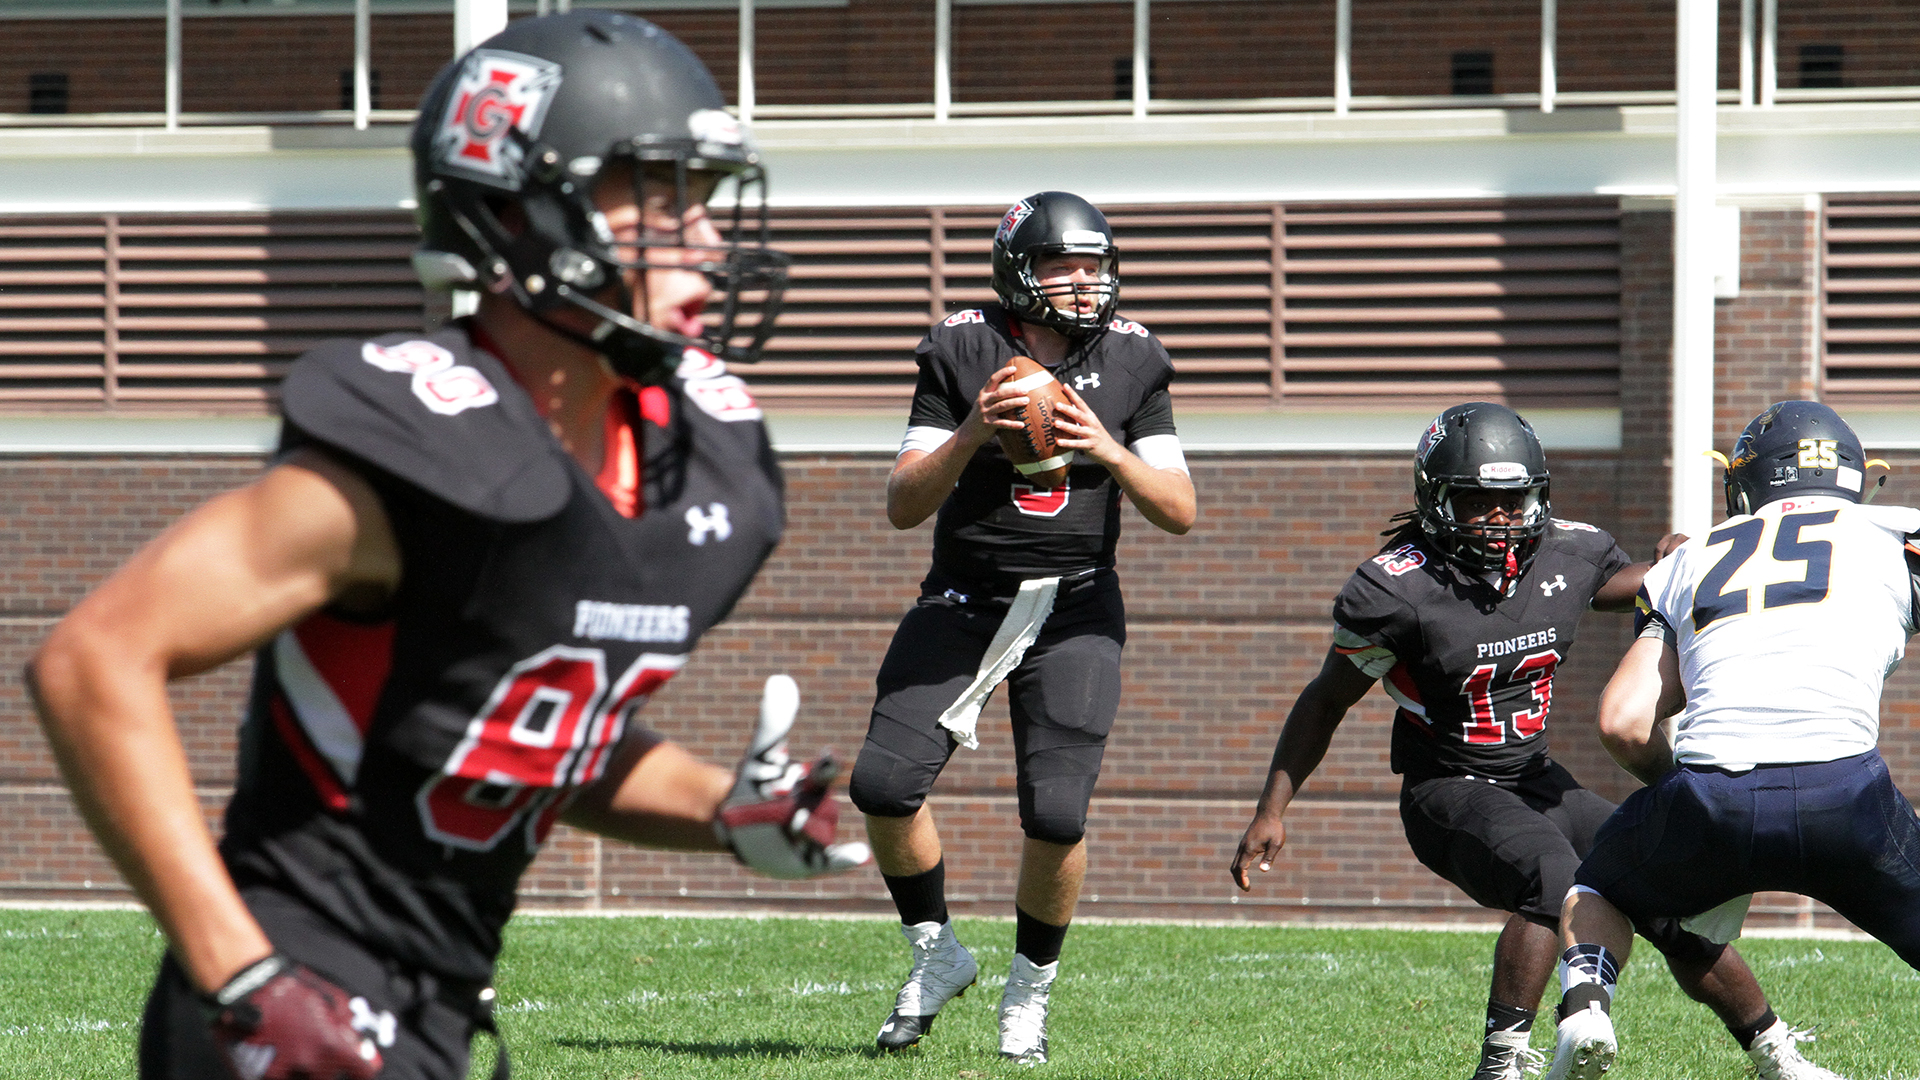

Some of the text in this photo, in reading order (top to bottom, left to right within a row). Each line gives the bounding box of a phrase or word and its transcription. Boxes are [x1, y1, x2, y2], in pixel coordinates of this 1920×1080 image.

[1798, 438, 1839, 470] 25
[1372, 543, 1428, 577] 13
[1691, 508, 1843, 634] 25
[573, 600, 690, 642] PIONEERS
[1476, 627, 1558, 658] PIONEERS
[1459, 648, 1562, 746] 13
